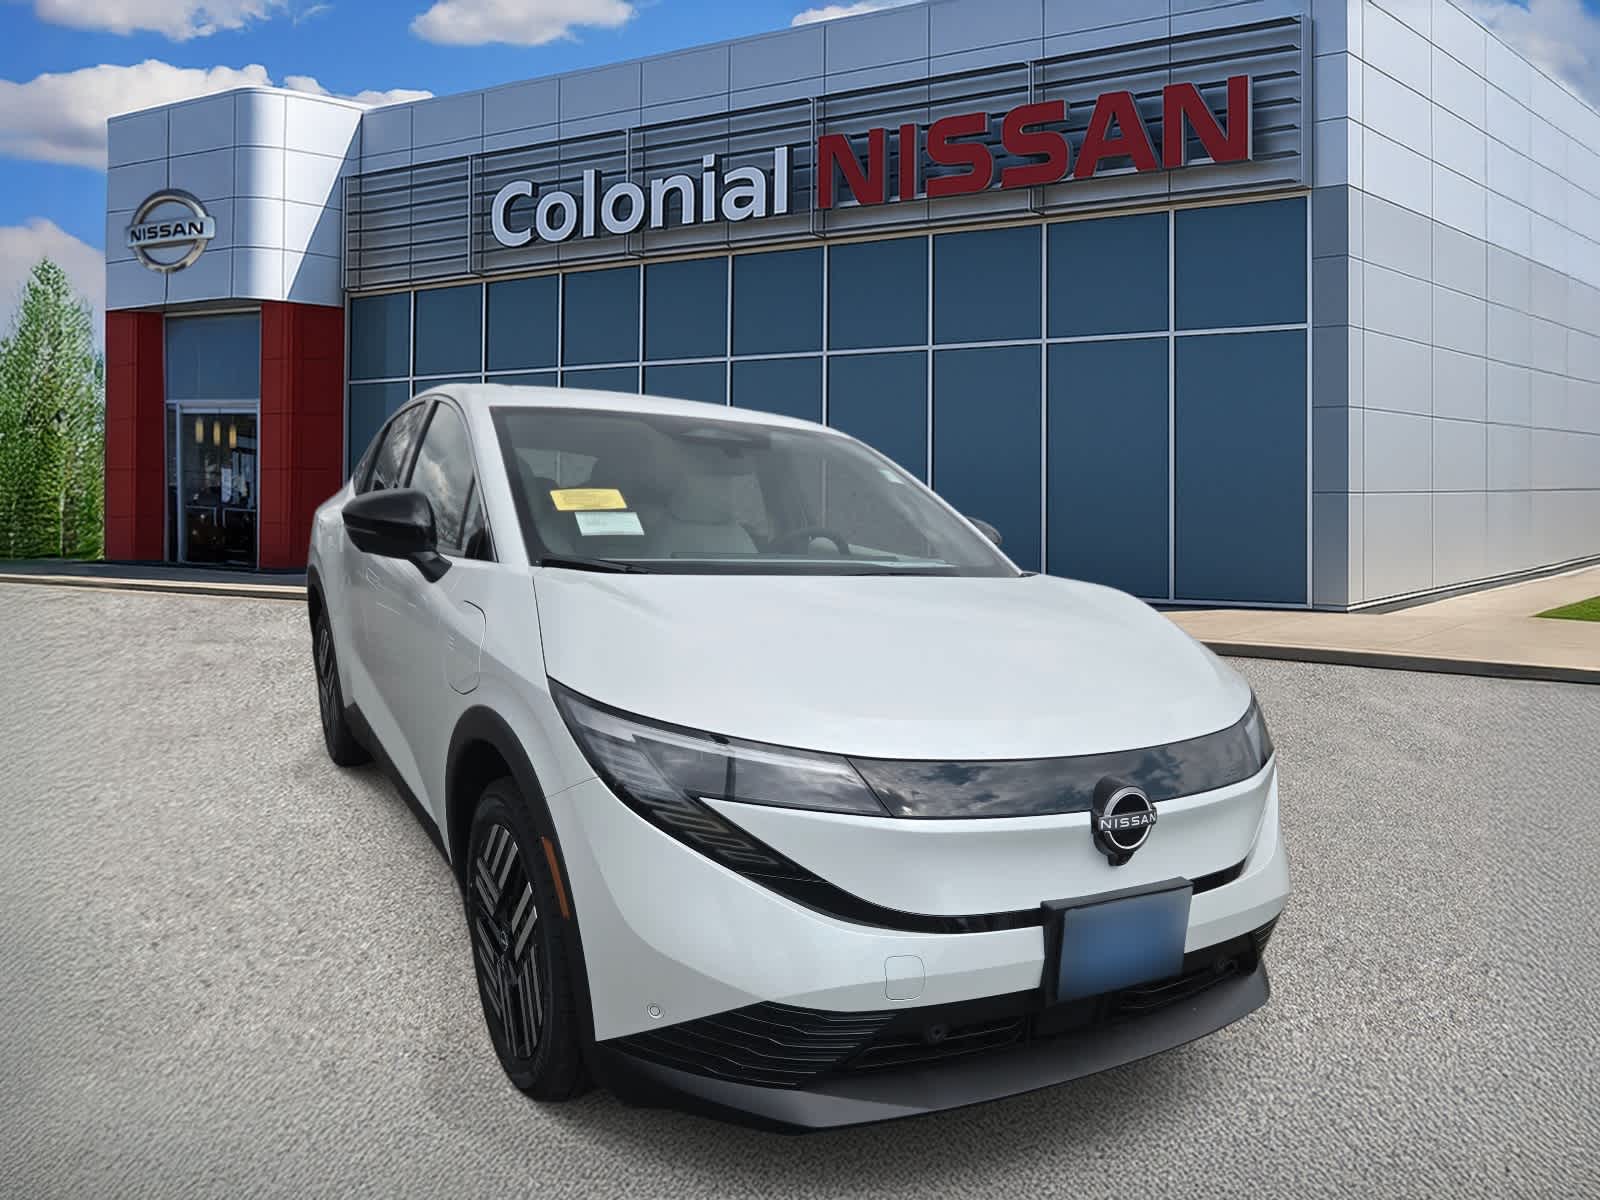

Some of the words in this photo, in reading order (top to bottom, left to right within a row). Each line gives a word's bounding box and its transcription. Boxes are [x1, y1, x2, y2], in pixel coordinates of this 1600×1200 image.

[490, 145, 792, 248] Colonial
[817, 75, 1254, 209] NISSAN
[130, 221, 204, 243] NISSAN
[1100, 813, 1156, 830] NISSAN
